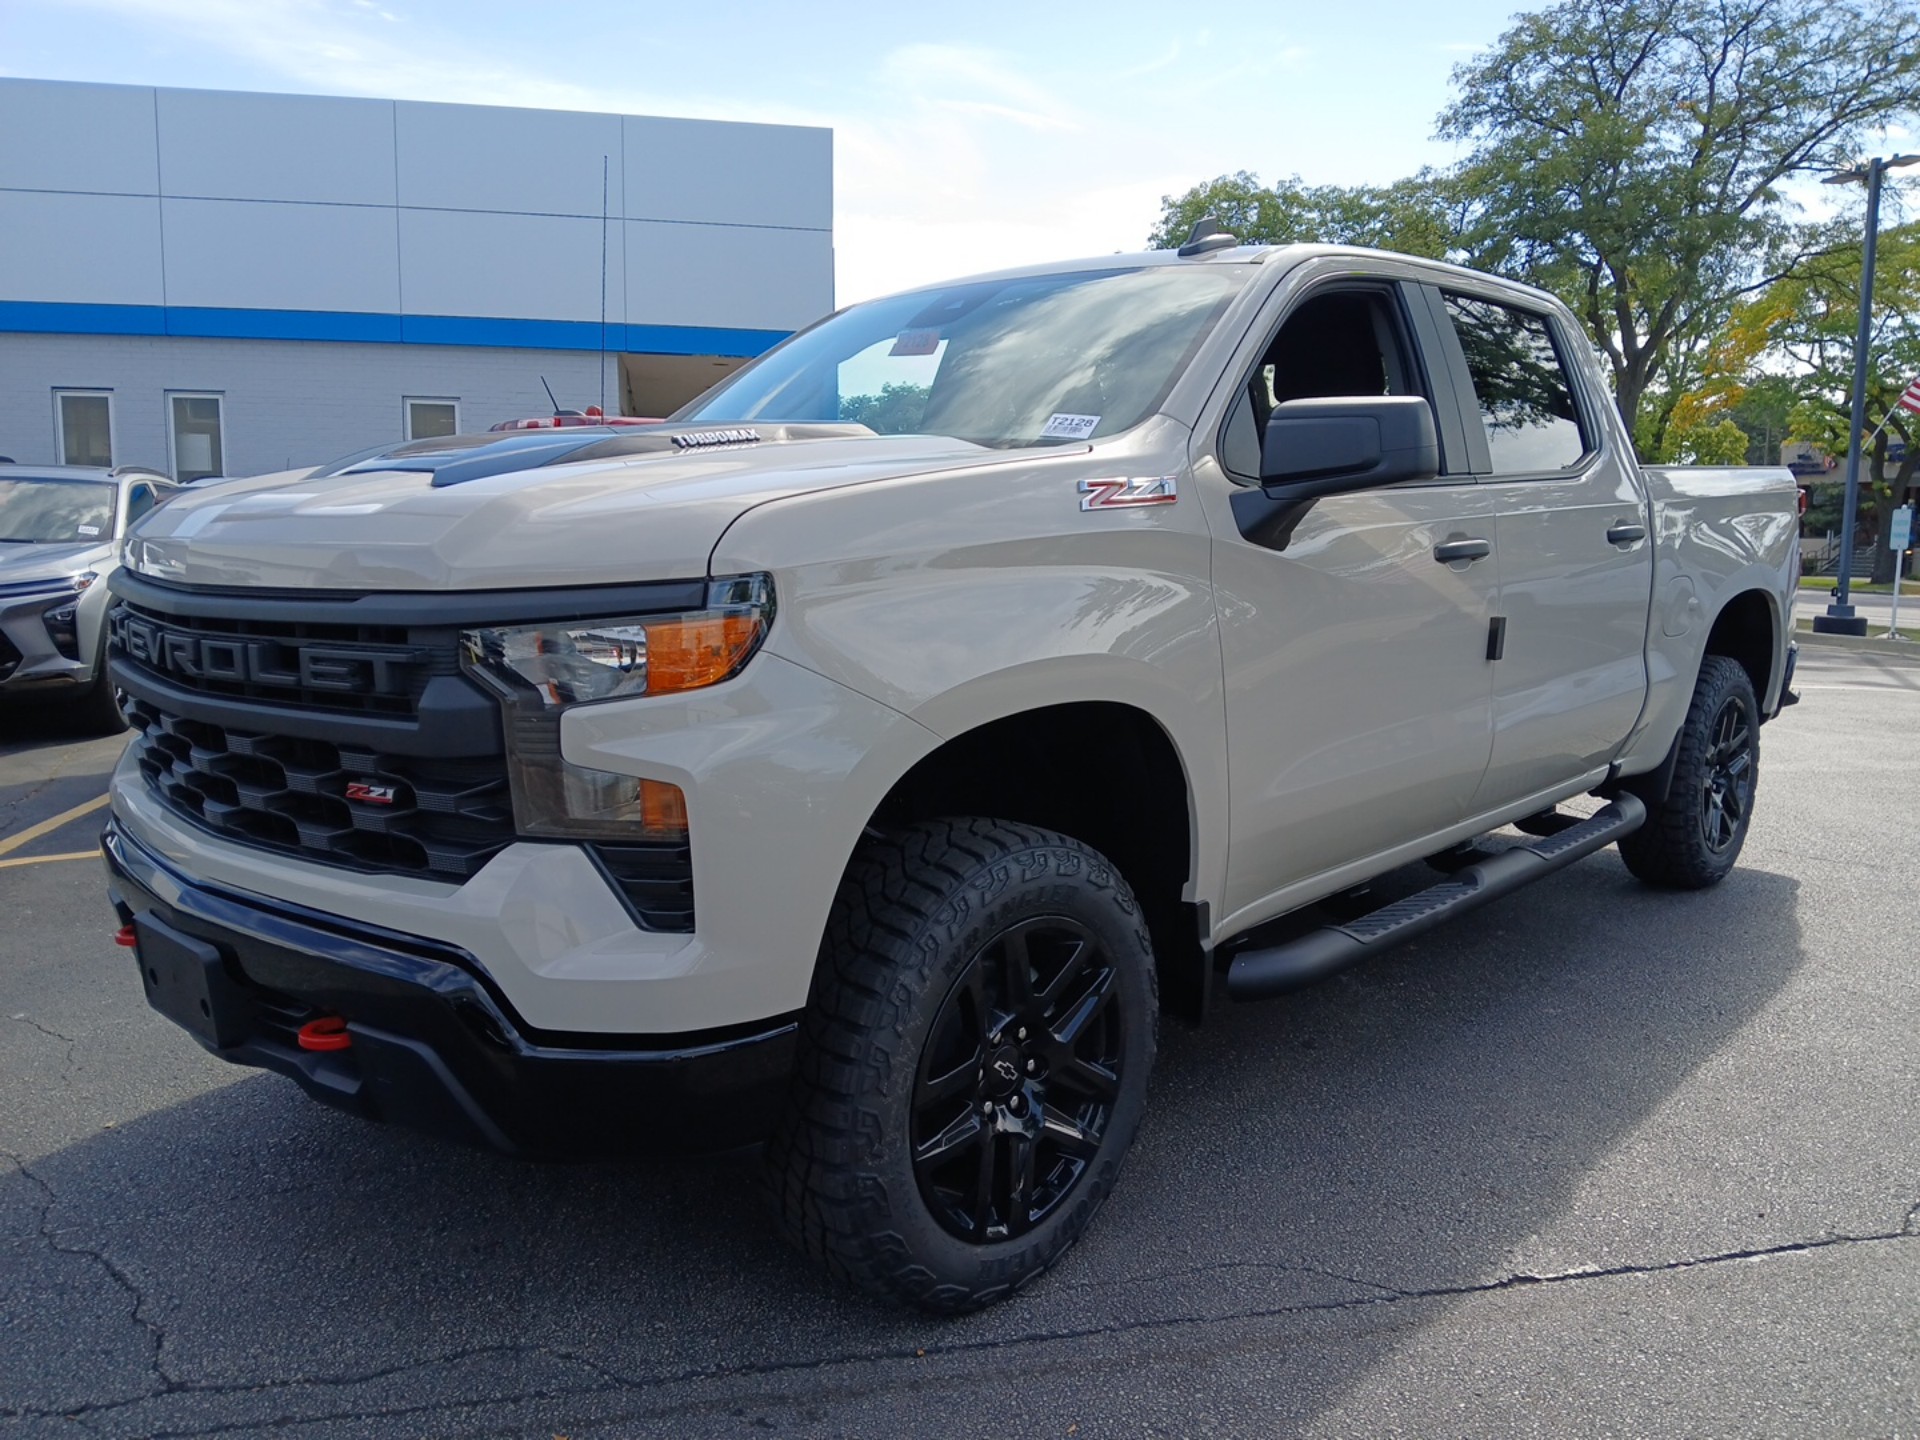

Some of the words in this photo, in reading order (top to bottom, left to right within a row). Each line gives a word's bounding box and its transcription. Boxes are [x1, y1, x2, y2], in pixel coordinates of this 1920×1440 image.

[1051, 416, 1094, 428] T2128
[671, 428, 760, 448] TURBOMAX
[1078, 476, 1178, 512] Z71
